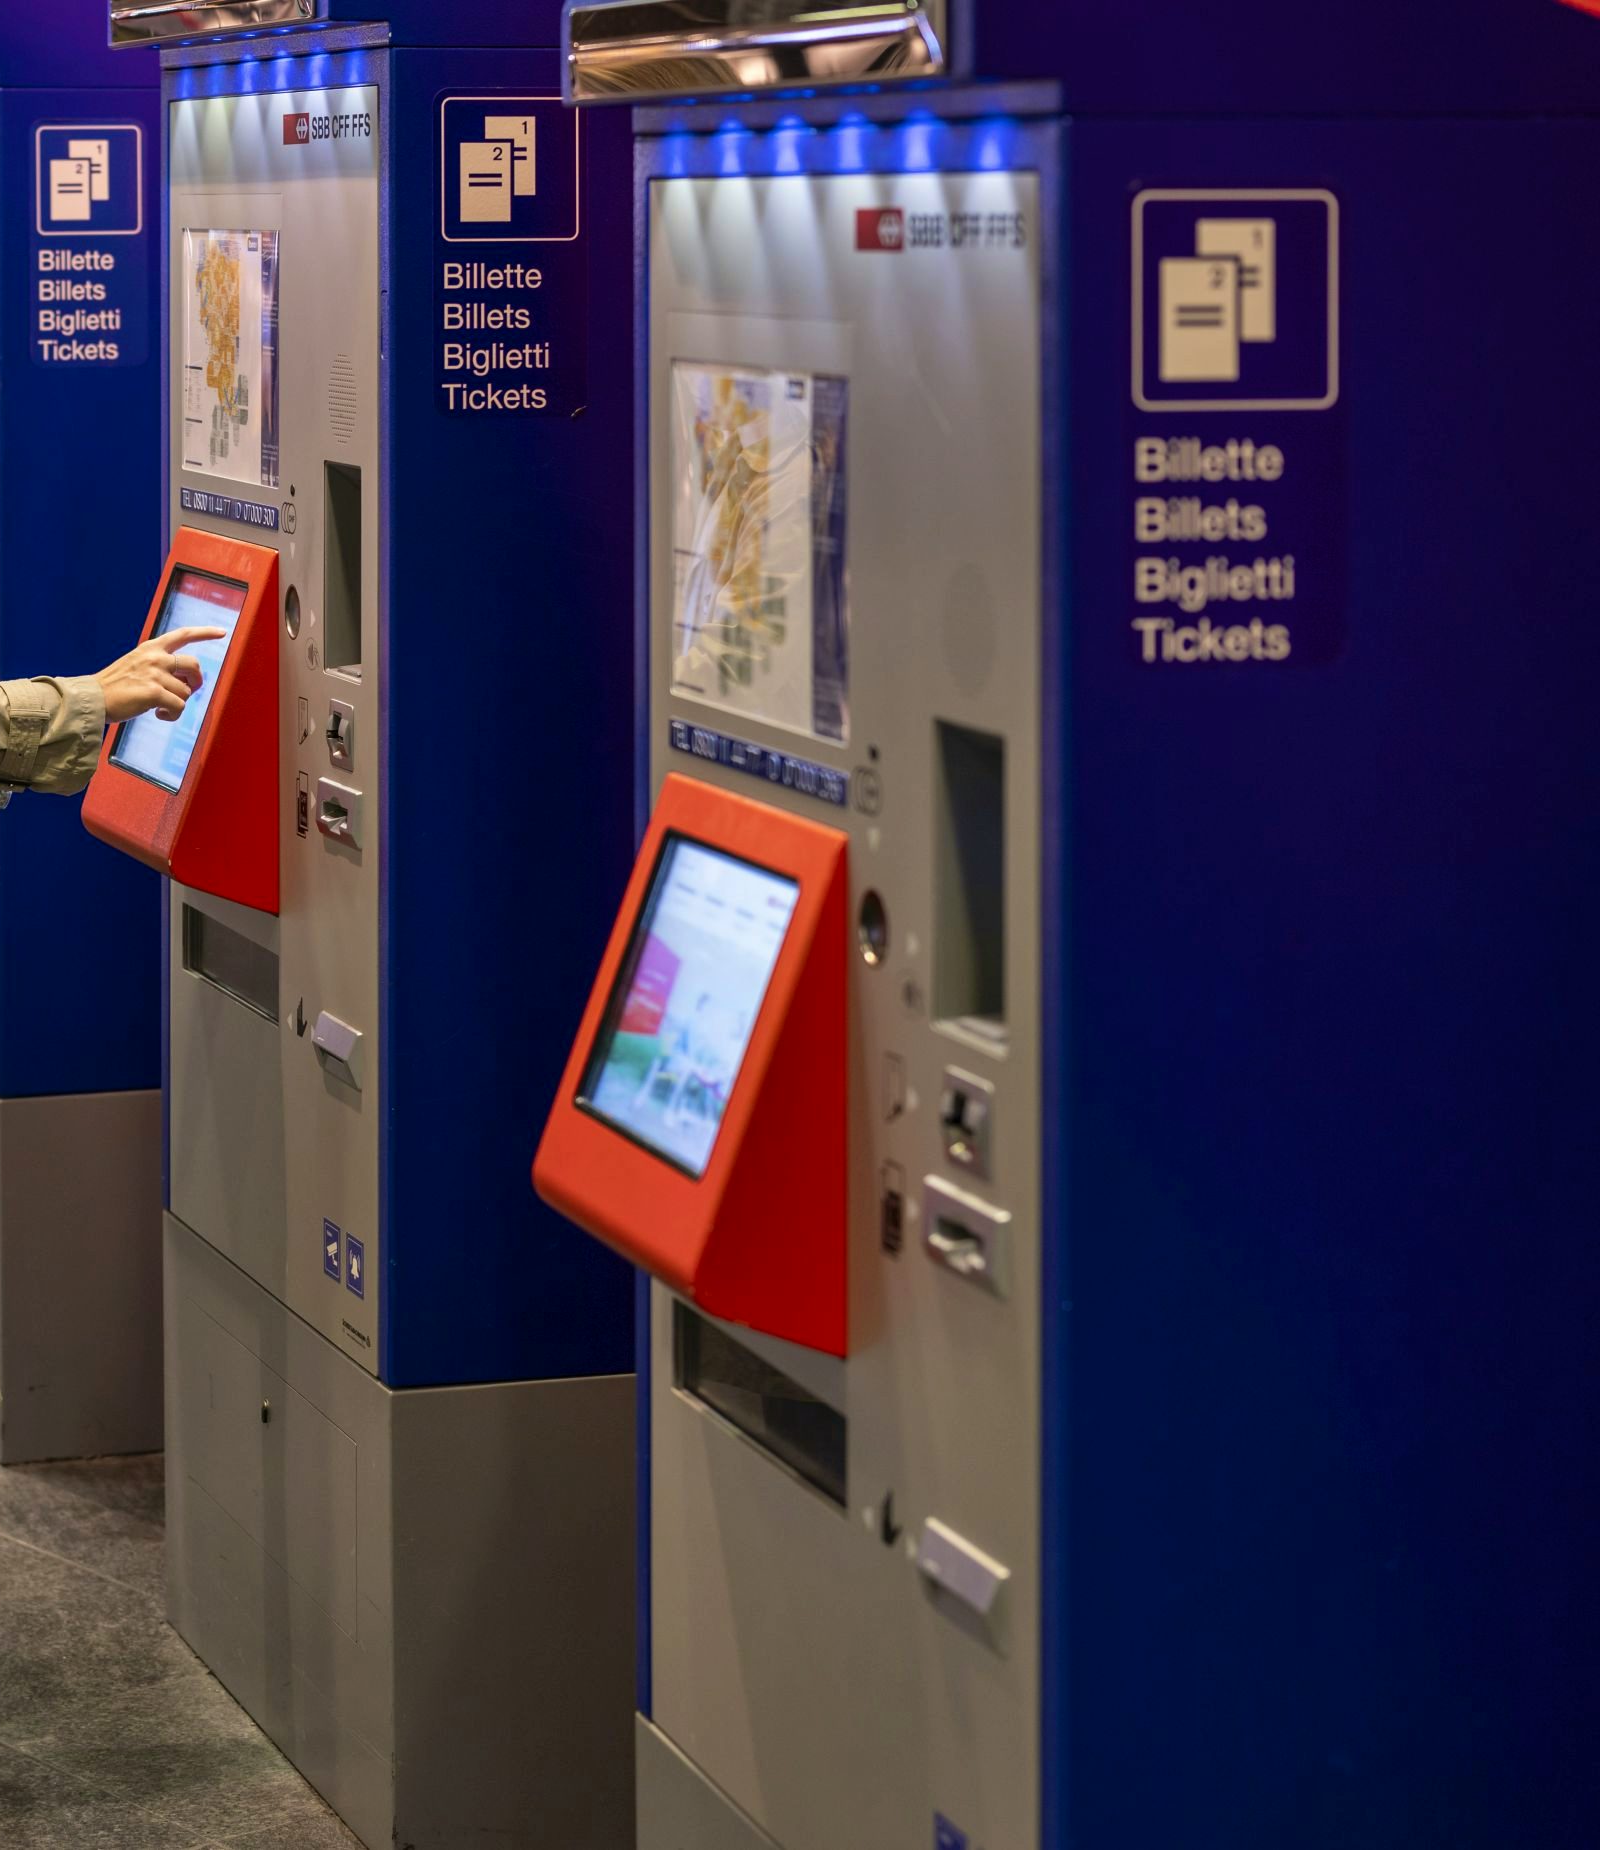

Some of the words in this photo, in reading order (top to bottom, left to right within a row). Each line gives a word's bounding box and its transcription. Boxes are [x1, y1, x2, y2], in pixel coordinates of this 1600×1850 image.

[312, 116, 330, 140] SBB
[332, 114, 350, 139] CFF
[352, 112, 371, 138] FFS
[521, 120, 528, 134] 1
[97, 144, 102, 154] 1
[493, 146, 503, 160] 2
[76, 164, 83, 174] 2
[38, 250, 114, 271] Billette
[443, 262, 542, 290] Billette
[38, 280, 106, 301] Billets
[38, 309, 121, 336] Biglietti
[443, 302, 531, 330] Billets
[38, 340, 119, 361] Tickets
[443, 342, 550, 376] Biglietti
[442, 383, 547, 410] Tickets
[1135, 437, 1285, 482] Billette
[1135, 497, 1268, 543] Billets
[1135, 554, 1295, 613] Biglietti
[1131, 616, 1292, 663] Tickets
